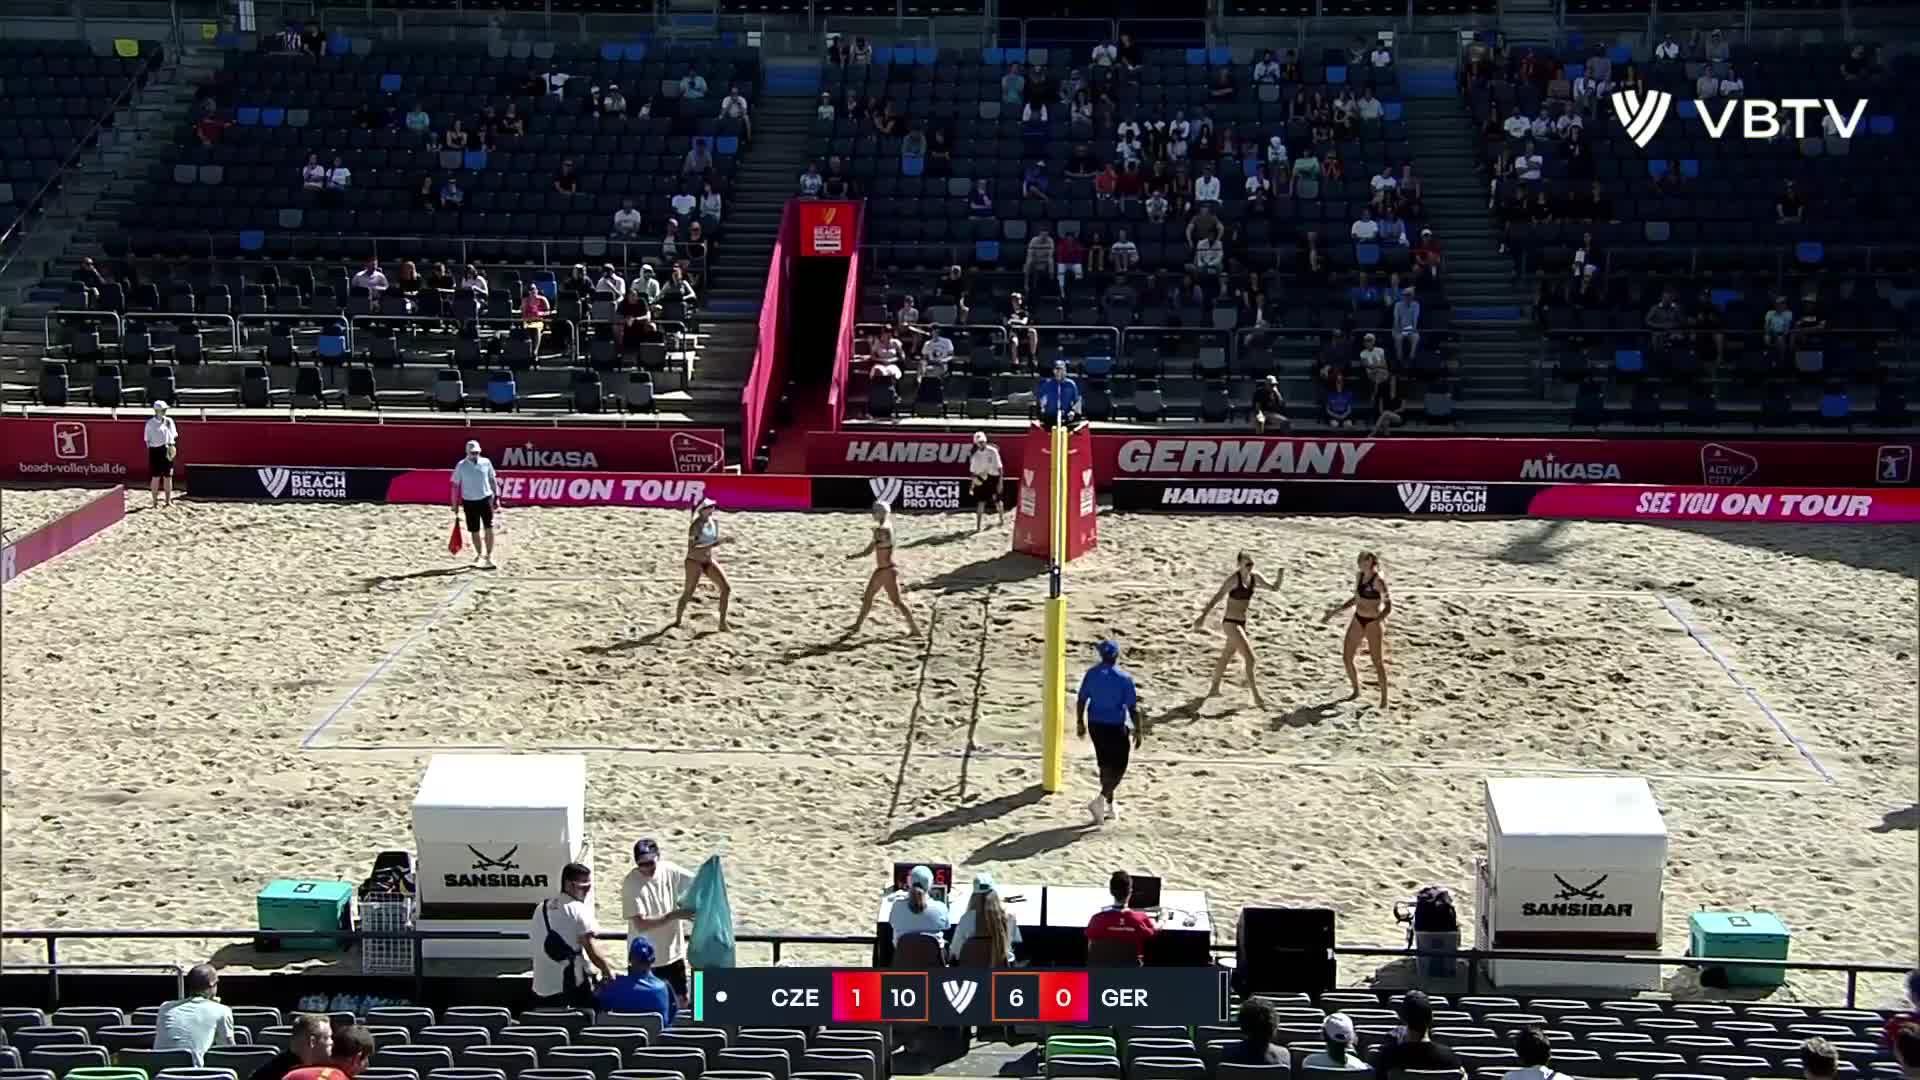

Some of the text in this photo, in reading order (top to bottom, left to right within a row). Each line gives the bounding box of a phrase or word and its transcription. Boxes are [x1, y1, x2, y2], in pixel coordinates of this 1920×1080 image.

[679, 454, 713, 463] ACTIVE
[846, 441, 974, 463] HAMBUR
[1118, 439, 1375, 474] GERMANY
[20, 463, 126, 475] beach-volleyball.de
[680, 464, 702, 472] CITY
[291, 475, 346, 488] BEACH
[291, 488, 346, 498] PRO TOUR
[528, 478, 566, 500] YOU
[568, 479, 615, 500] ON
[621, 480, 706, 503] TOUR
[903, 485, 960, 498] BEACH
[1161, 488, 1279, 504] HAMBURG
[1431, 490, 1487, 503] BEACH
[903, 499, 959, 508] PRO TOUR
[1430, 503, 1486, 513] PRO TOUR
[1636, 492, 1872, 516] SEE YOU ON TOUR
[444, 873, 548, 887] SANSIBAR
[1522, 903, 1632, 917] SANSIBAR
